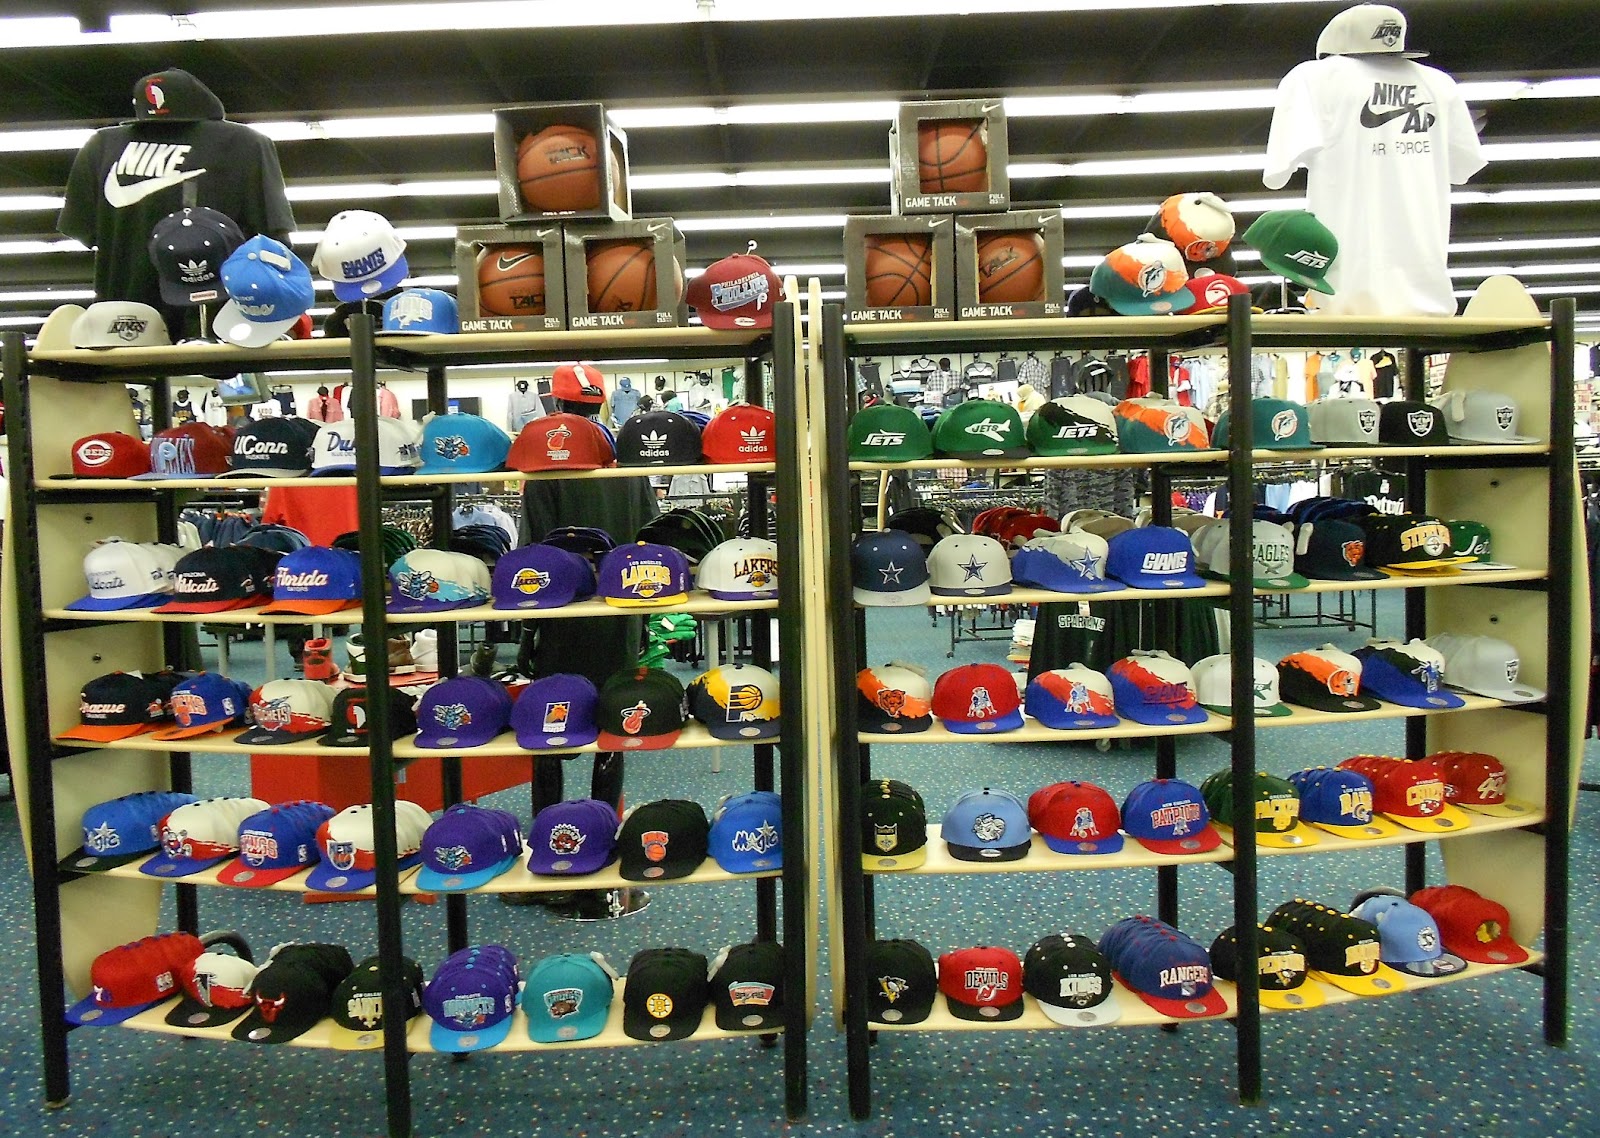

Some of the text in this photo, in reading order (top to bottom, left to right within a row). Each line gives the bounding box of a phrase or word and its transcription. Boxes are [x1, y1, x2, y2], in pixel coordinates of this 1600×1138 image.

[1372, 82, 1417, 107] NIKE
[117, 141, 192, 177] NIKE
[905, 196, 957, 208] GAME TACK
[341, 247, 386, 278] GIANTS
[1284, 250, 1330, 269] JETS
[181, 271, 214, 284] adidas
[851, 309, 902, 320] GAME TACK
[961, 305, 1013, 317] GAME TACK
[108, 319, 149, 336] KINGS
[462, 319, 513, 331] GAME TACK
[572, 315, 624, 327] GAME TACK
[861, 430, 906, 446] JETS
[972, 424, 999, 433] JETS
[1052, 422, 1098, 439] JETS
[234, 435, 288, 455] UConn
[327, 431, 356, 452] Du
[738, 445, 768, 453] adidas
[639, 449, 670, 457] adidas
[1453, 535, 1491, 556] Jet
[734, 558, 777, 579] LAKERS
[1141, 551, 1188, 572] GIANTS
[277, 567, 329, 587] Florida
[621, 564, 672, 589] LAKERS
[1058, 614, 1106, 632] SPARTANS
[1151, 803, 1200, 829] PATRIOTS
[965, 970, 1009, 991] DEVILS
[1160, 965, 1208, 988] RANGERS
